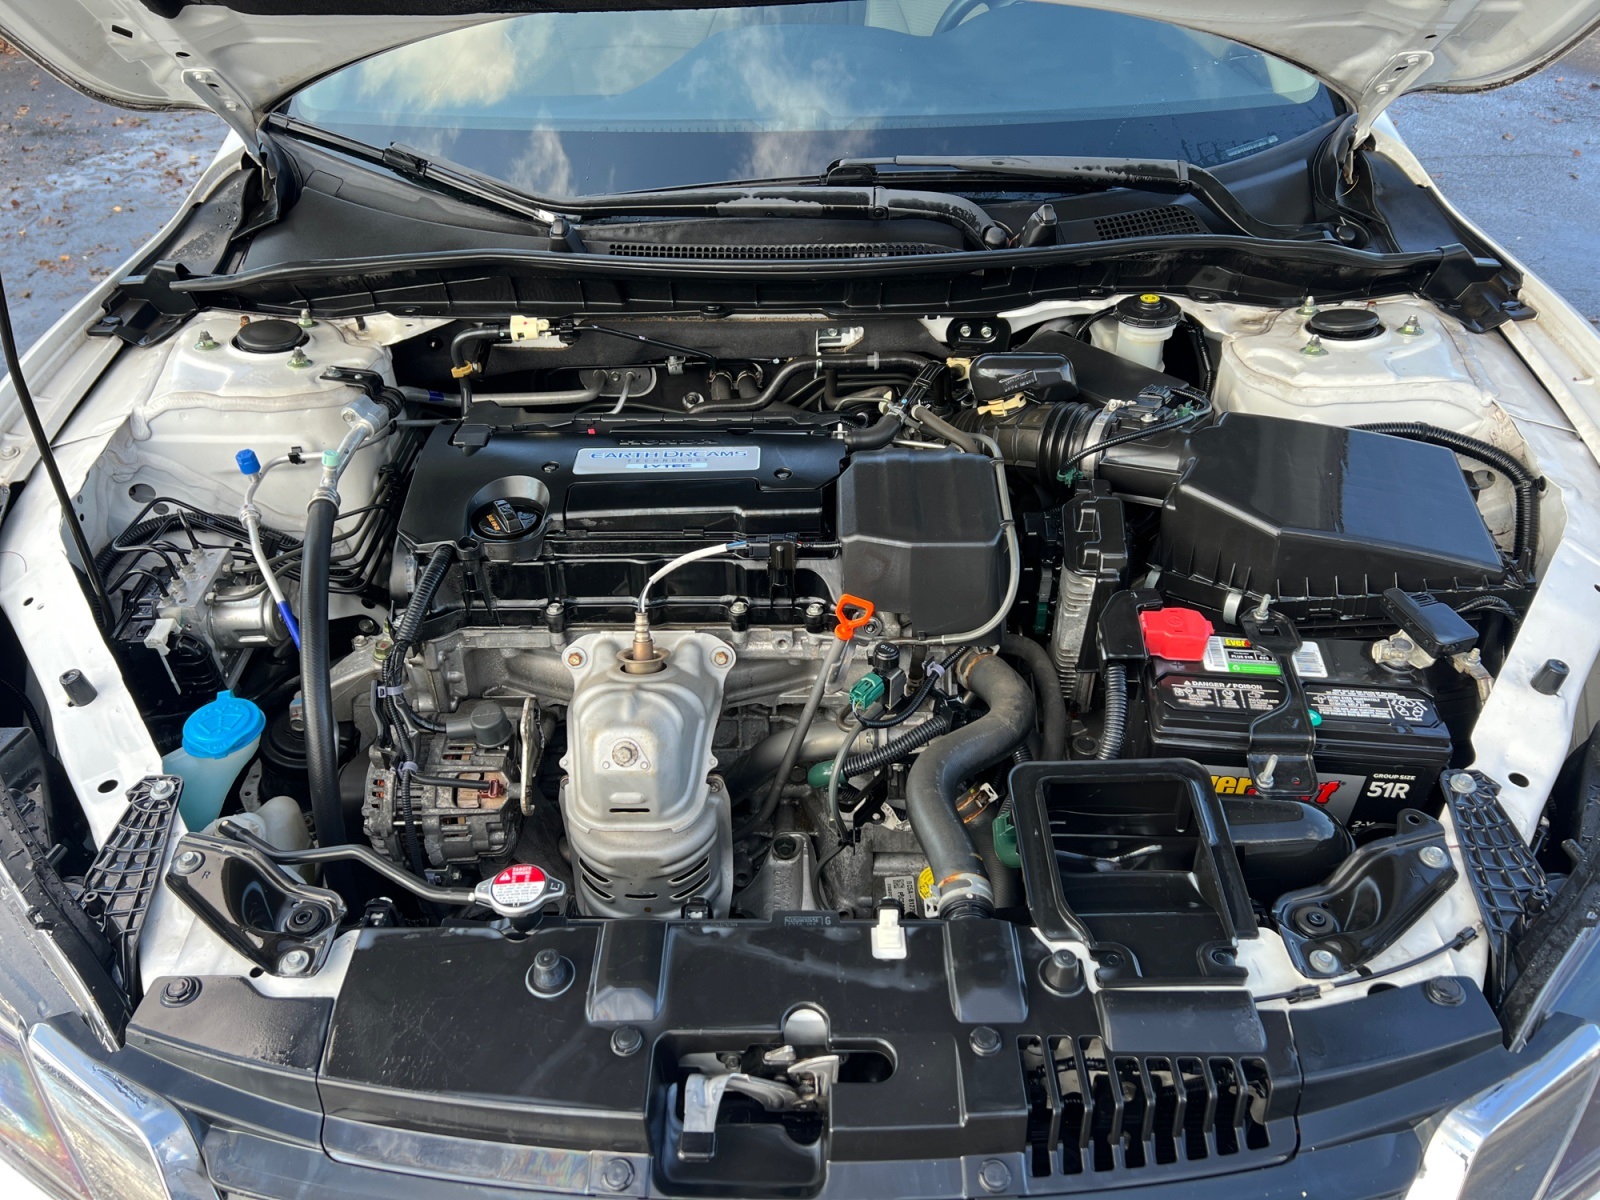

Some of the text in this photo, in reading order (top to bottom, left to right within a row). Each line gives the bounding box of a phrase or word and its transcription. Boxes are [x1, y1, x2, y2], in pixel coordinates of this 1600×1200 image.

[590, 450, 748, 459] EARTH DREAMS
[1366, 781, 1411, 799] 51R
